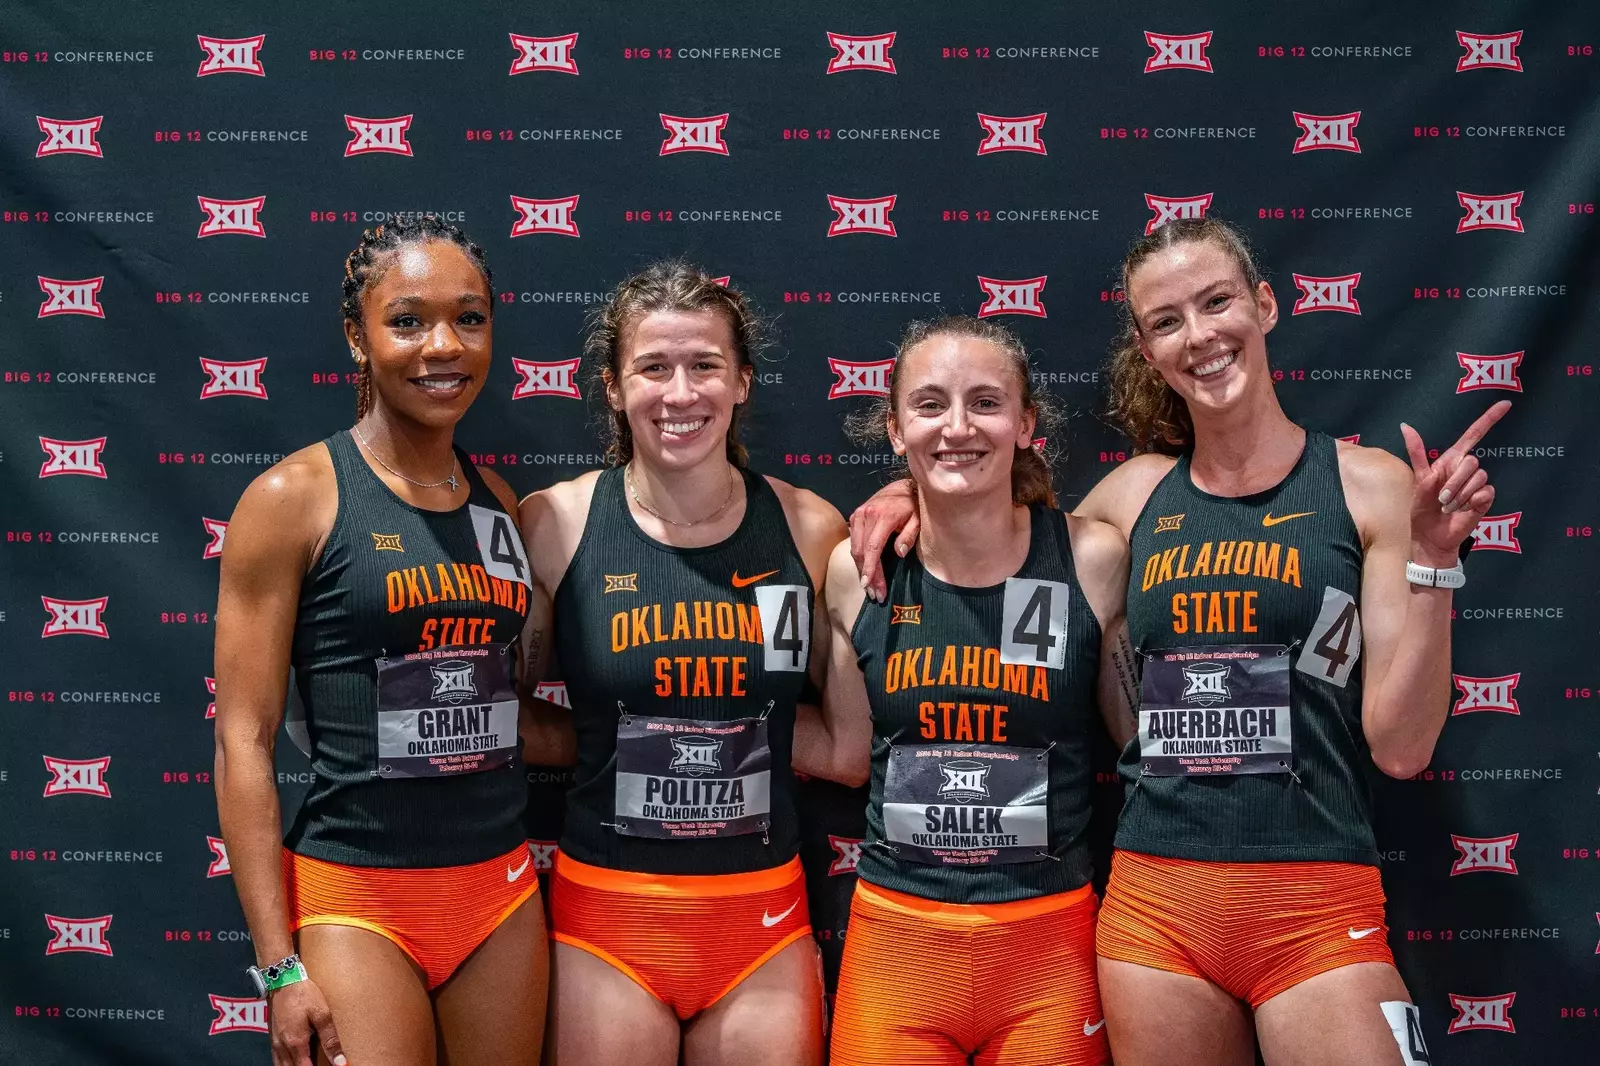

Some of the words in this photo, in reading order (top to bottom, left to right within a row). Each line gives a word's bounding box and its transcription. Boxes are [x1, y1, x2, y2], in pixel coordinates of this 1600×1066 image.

[3, 51, 29, 63] BIG
[35, 52, 48, 62] 12
[54, 51, 154, 62] CONFERENCE
[202, 40, 260, 72] XII
[309, 49, 336, 61] BIG
[342, 50, 356, 61] 12
[362, 49, 464, 61] CONFERENCE
[514, 38, 574, 71] XII
[623, 47, 651, 59] BIG
[657, 47, 672, 59] 12
[677, 47, 781, 59] CONFERENCE
[831, 36, 891, 69] XII
[942, 47, 969, 59] BIG
[975, 47, 990, 59] 12
[995, 47, 1099, 58] CONFERENCE
[1149, 36, 1208, 68] XII
[1258, 46, 1284, 57] BIG
[1291, 46, 1305, 57] 12
[1311, 46, 1412, 57] CONFERENCE
[1461, 36, 1518, 67] XII
[41, 121, 98, 153] XII
[155, 131, 181, 143] BIG
[187, 130, 201, 142] 12
[207, 130, 308, 142] CONFERENCE
[349, 120, 408, 152] XII
[466, 129, 493, 141] BIG
[500, 130, 514, 141] 12
[519, 129, 622, 141] CONFERENCE
[664, 118, 724, 151] XII
[783, 129, 810, 140] BIG
[816, 128, 831, 140] 12
[836, 128, 940, 140] CONFERENCE
[982, 117, 1042, 151] XII
[1100, 128, 1127, 139] BIG
[1134, 128, 1148, 139] 12
[1154, 127, 1256, 139] CONFERENCE
[1298, 116, 1356, 149] XII
[1413, 126, 1440, 137] BIG
[1446, 127, 1460, 137] 12
[1465, 126, 1566, 137] CONFERENCE
[3, 211, 29, 222] BIG
[35, 211, 49, 222] 12
[54, 211, 154, 223] CONFERENCE
[203, 201, 261, 232] XII
[515, 200, 575, 233] XII
[624, 210, 651, 222] BIG
[658, 210, 673, 222] 12
[678, 210, 782, 222] CONFERENCE
[832, 199, 892, 232] XII
[942, 210, 969, 222] BIG
[975, 210, 991, 222] 12
[996, 209, 1099, 221] CONFERENCE
[1258, 207, 1285, 219] BIG
[1291, 207, 1305, 219] 12
[1311, 207, 1412, 219] CONFERENCE
[1462, 196, 1519, 228] XII
[43, 281, 100, 313] XII
[155, 292, 182, 303] BIG
[188, 292, 202, 303] 12
[208, 292, 309, 303] CONFERENCE
[783, 291, 811, 303] BIG
[817, 292, 831, 303] 12
[837, 291, 941, 303] CONFERENCE
[982, 280, 1042, 314] XII
[1298, 278, 1356, 310] XII
[1413, 287, 1440, 299] BIG
[1446, 287, 1460, 299] 12
[1465, 285, 1567, 299] CONFERENCE
[4, 371, 31, 383] BIG
[37, 372, 51, 383] 12
[56, 372, 156, 384] CONFERENCE
[205, 362, 263, 395] XII
[517, 362, 577, 395] XII
[833, 361, 892, 395] XII
[1290, 369, 1305, 381] 12
[1310, 368, 1412, 381] CONFERENCE
[1461, 356, 1519, 389] XII
[44, 442, 102, 474] XII
[6, 531, 32, 542] BIG
[39, 532, 52, 543] 12
[58, 532, 159, 543] CONFERENCE
[490, 515, 525, 579] 4
[1141, 540, 1302, 593] OKLAHOMA
[386, 563, 527, 617] OKLAHOMA
[46, 601, 103, 633] XII
[611, 601, 765, 653] OKLAHOM
[1012, 585, 1057, 662] 4
[1172, 591, 1258, 634] STATE
[418, 617, 496, 652] STATE
[773, 591, 803, 667] 4
[1313, 601, 1357, 678] 4
[433, 667, 475, 695] XII
[654, 656, 748, 697] STATE
[885, 645, 1049, 702] OKLAHOMA
[1184, 671, 1229, 697] XII
[8, 691, 35, 702] BIG
[41, 692, 55, 702] 12
[60, 691, 161, 703] CONFERENCE
[1457, 678, 1516, 711] XII
[418, 705, 493, 739] GRANT
[919, 701, 1008, 742] STATE
[1148, 709, 1277, 740] AUERBACH
[408, 738, 473, 755] OKLAHOMA
[473, 734, 499, 751] STATE
[672, 742, 719, 768] XII
[1162, 740, 1222, 755] OKLAHOMA
[1225, 739, 1262, 753] STATE
[49, 761, 106, 793] XII
[941, 768, 988, 793] XII
[1441, 770, 1455, 781] 12
[1460, 768, 1562, 781] CONFERENCE
[645, 776, 745, 806] POLITZA
[642, 804, 709, 820] OKLAHOMA
[711, 804, 745, 819] STATE
[925, 806, 1004, 834] SALEK
[10, 850, 37, 861] BIG
[42, 850, 56, 861] 12
[62, 850, 163, 862] CONFERENCE
[911, 833, 979, 848] OKLAHOMA
[982, 834, 1018, 846] STATE
[1456, 838, 1514, 871] XII
[50, 920, 108, 951] XII
[1406, 930, 1433, 942] BIG
[1440, 929, 1453, 941] 12
[1459, 927, 1560, 940] CONFERENCE
[15, 1006, 40, 1017] BIG
[46, 1007, 60, 1018] 12
[65, 1007, 165, 1020] CONFERENCE
[1453, 997, 1511, 1029] XII
